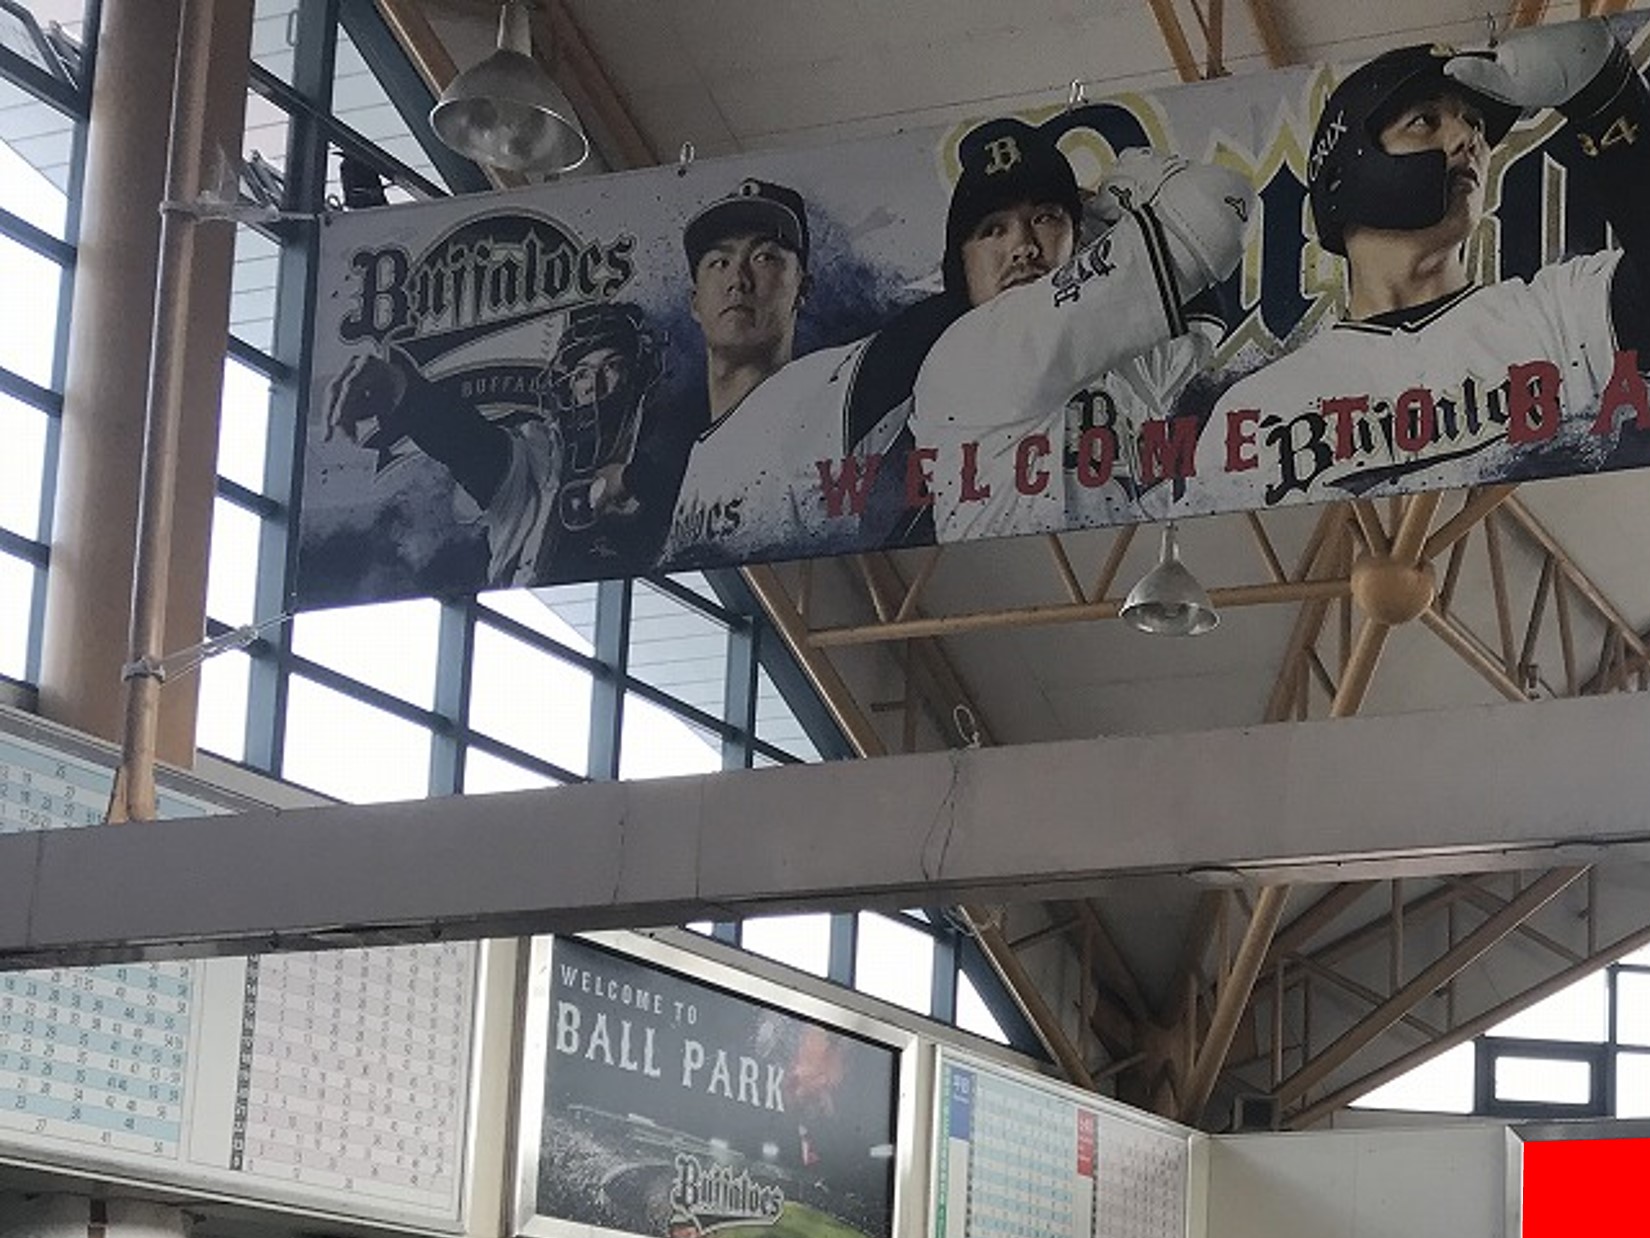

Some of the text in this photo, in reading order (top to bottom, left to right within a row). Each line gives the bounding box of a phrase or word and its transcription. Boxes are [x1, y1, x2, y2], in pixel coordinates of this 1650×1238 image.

[338, 229, 639, 343] Buffaloes
[816, 408, 1261, 519] WELCOME
[1319, 386, 1437, 461] TO
[560, 963, 698, 1025] WELCOME TO
[555, 999, 785, 1113] BALL PARK
